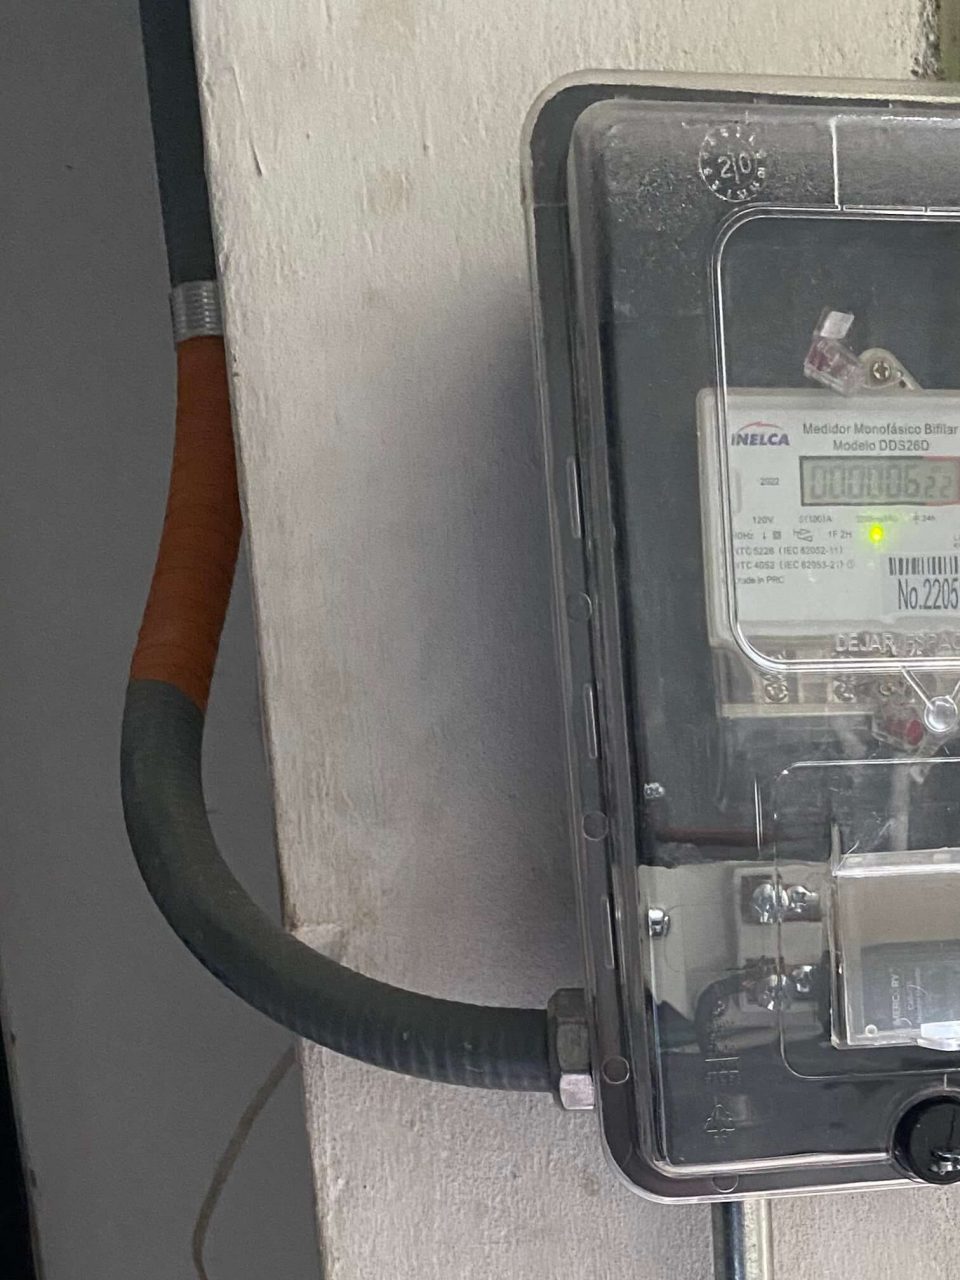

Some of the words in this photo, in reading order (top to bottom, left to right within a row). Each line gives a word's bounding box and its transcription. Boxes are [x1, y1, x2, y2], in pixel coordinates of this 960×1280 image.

[803, 422, 850, 435] Medidor
[854, 421, 922, 435] Monofásico
[924, 422, 958, 435] Bifilar
[731, 433, 790, 446] INELCA
[833, 440, 876, 451] Modelo
[879, 440, 930, 451] DDS26D
[752, 516, 774, 524] 120V
[836, 633, 896, 652] DEJAR
[890, 974, 901, 1025] MERCRY
